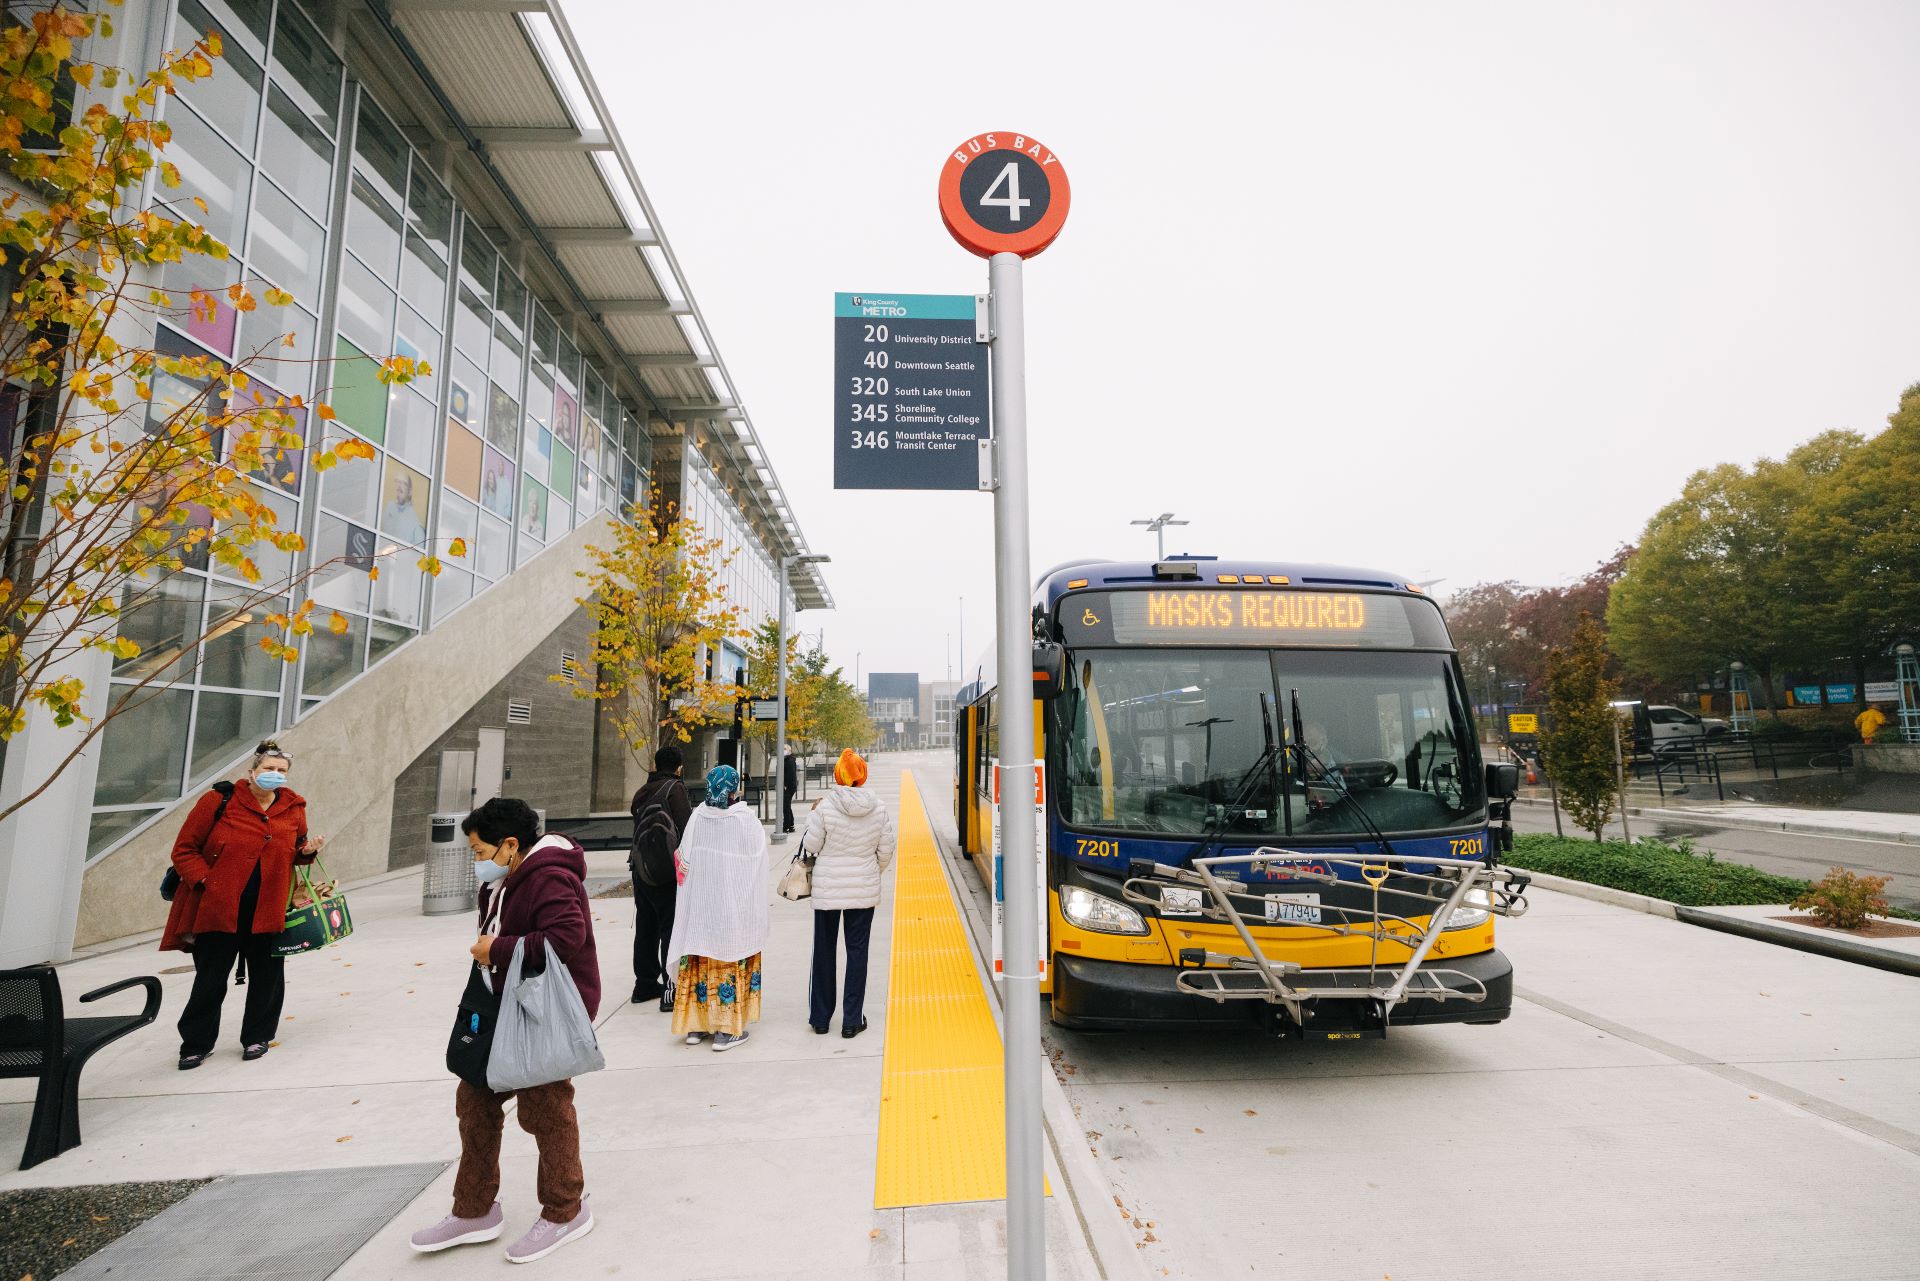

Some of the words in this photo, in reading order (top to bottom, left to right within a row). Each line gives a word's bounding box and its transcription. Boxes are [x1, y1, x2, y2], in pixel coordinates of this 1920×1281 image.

[954, 134, 997, 164] BUS
[1014, 135, 1057, 166] BAY
[979, 162, 1030, 221] 4
[863, 299, 877, 307] King
[877, 299, 899, 307] County
[863, 307, 907, 317] METRO
[864, 325, 889, 343] 20
[894, 334, 938, 346] University
[940, 335, 972, 345] District
[863, 351, 889, 369] 40
[895, 361, 943, 371] Downtown
[945, 361, 975, 371] Seattle
[851, 377, 889, 396] 320
[895, 387, 920, 397] South
[923, 388, 943, 397] Lake
[945, 388, 971, 397] Union
[851, 403, 889, 422] 345
[895, 404, 937, 413] Shoreline
[895, 414, 945, 425] Community
[947, 414, 980, 426] College
[851, 430, 889, 450] 346
[895, 431, 942, 440] Mountlake
[944, 431, 976, 441] Terrace
[895, 441, 925, 450] Transit
[927, 441, 957, 450] Center
[1149, 592, 1233, 627] MASKS
[1241, 594, 1364, 628] REQUIRED
[1076, 839, 1119, 857] 7201
[1449, 838, 1483, 856] 7201
[1278, 903, 1318, 918] 7794C
